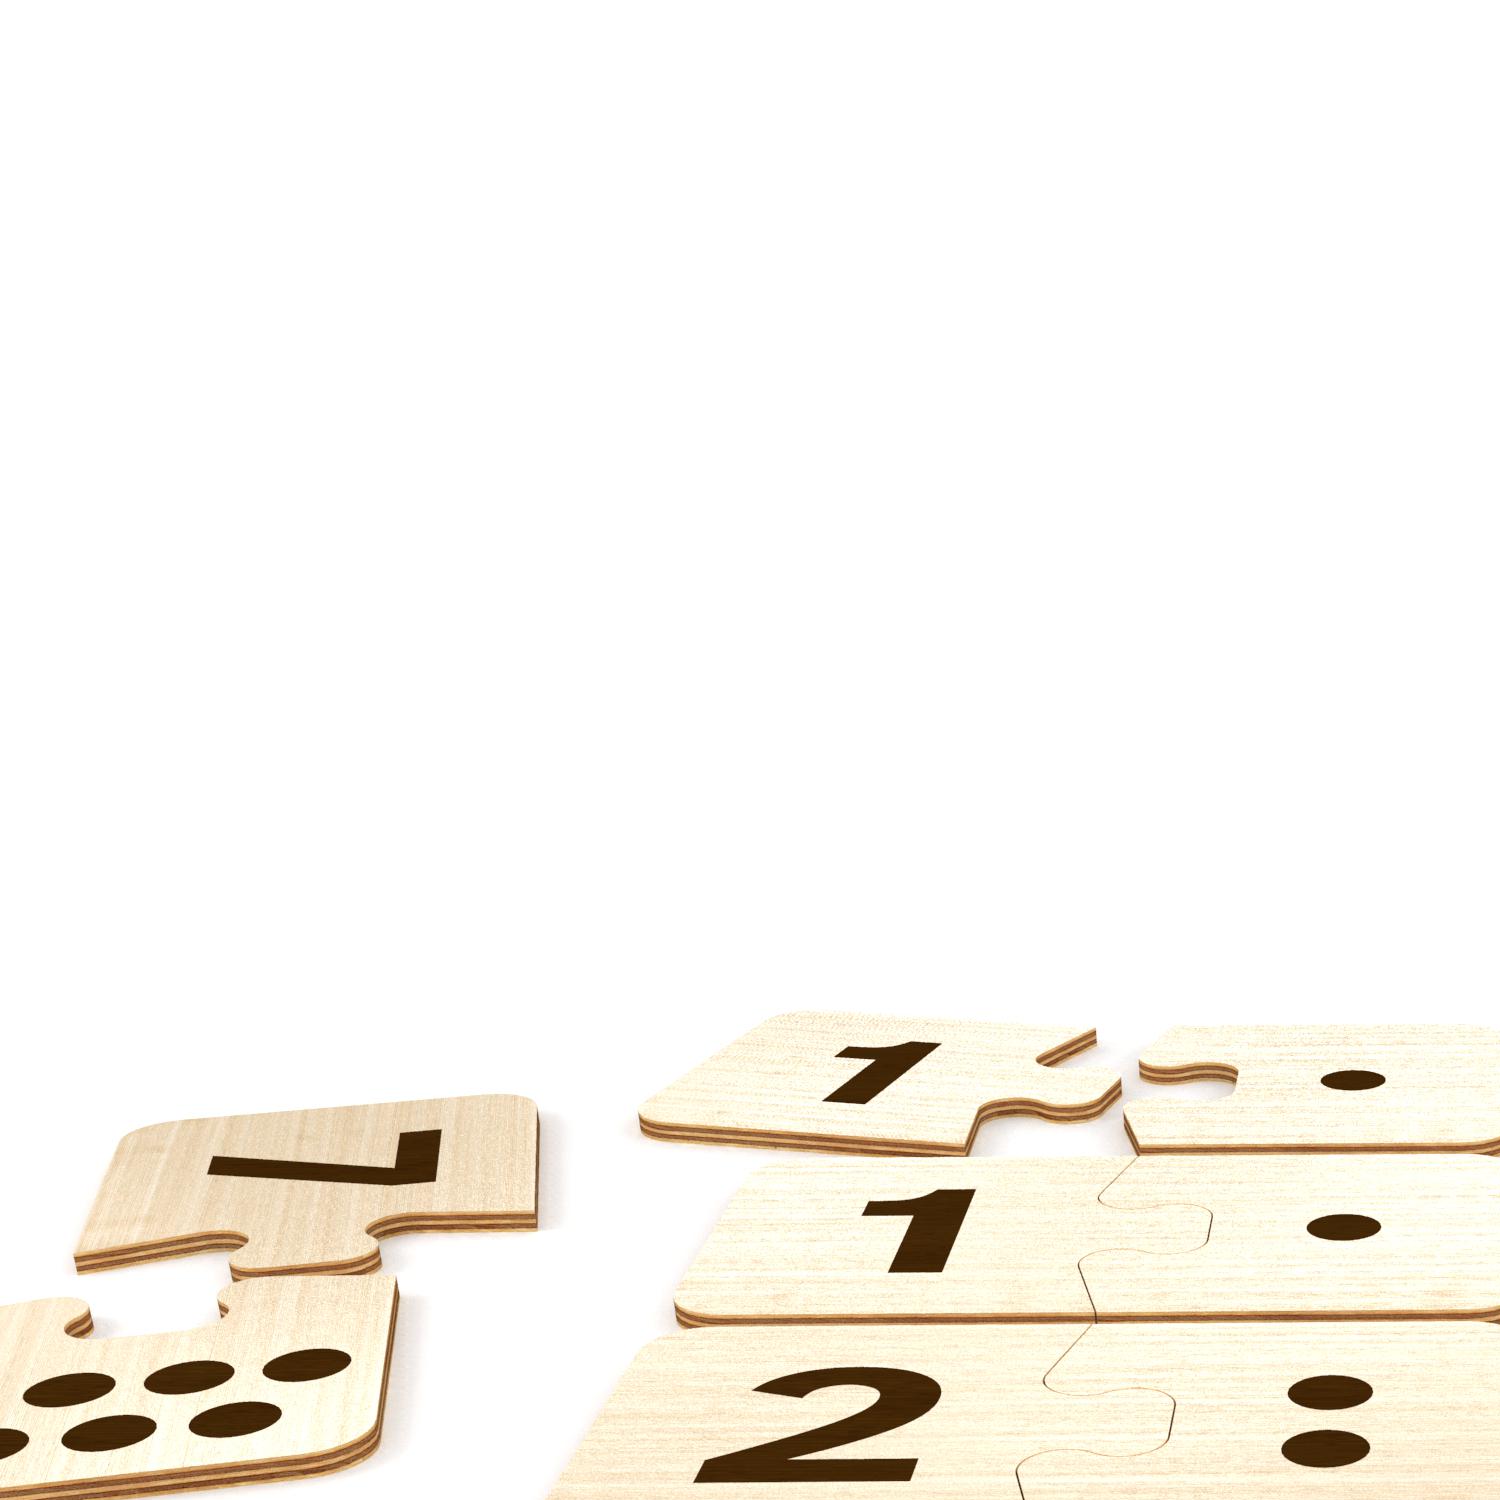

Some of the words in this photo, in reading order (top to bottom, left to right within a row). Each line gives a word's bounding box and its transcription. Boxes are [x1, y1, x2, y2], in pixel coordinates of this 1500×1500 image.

[822, 1041, 941, 1105] 1
[207, 1129, 442, 1186] 7
[862, 1189, 976, 1273] 1
[693, 1366, 942, 1484] 2
